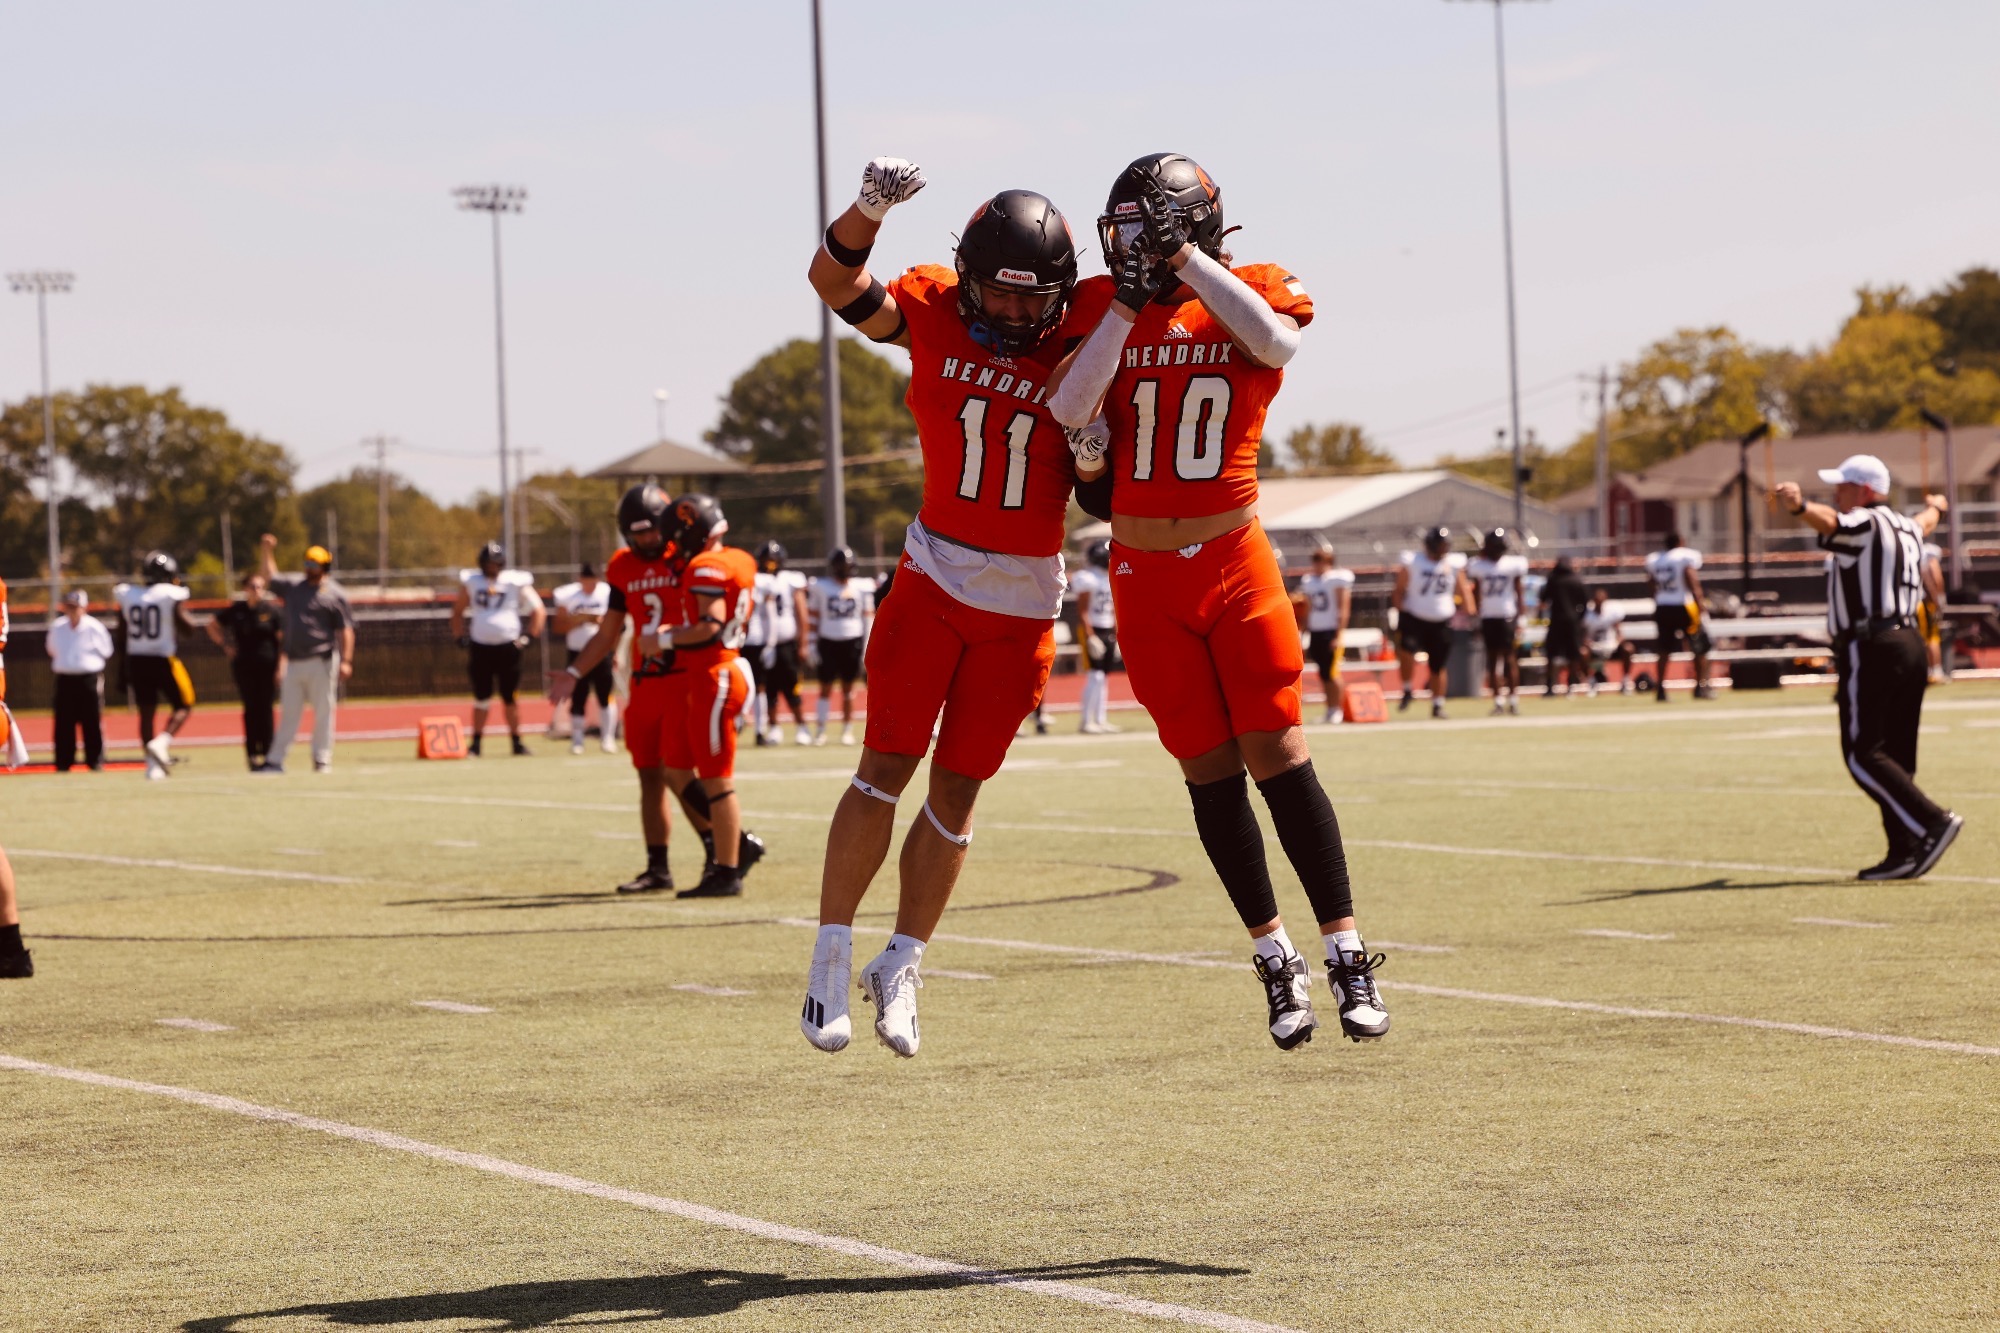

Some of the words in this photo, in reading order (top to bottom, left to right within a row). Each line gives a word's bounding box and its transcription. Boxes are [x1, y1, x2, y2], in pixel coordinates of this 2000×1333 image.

[1117, 203, 1139, 212] Ridd
[1001, 271, 1033, 282] Riddell
[1123, 234, 1149, 289] JORA
[1163, 330, 1193, 340] adidas
[988, 357, 1018, 371] adidas
[1125, 342, 1233, 368] HENDRIX
[940, 357, 1050, 408] HENDRI
[1129, 373, 1233, 481] 10
[954, 394, 1037, 510] 11
[130, 604, 161, 639] 90
[641, 592, 664, 636] 3
[426, 723, 460, 752] 20
